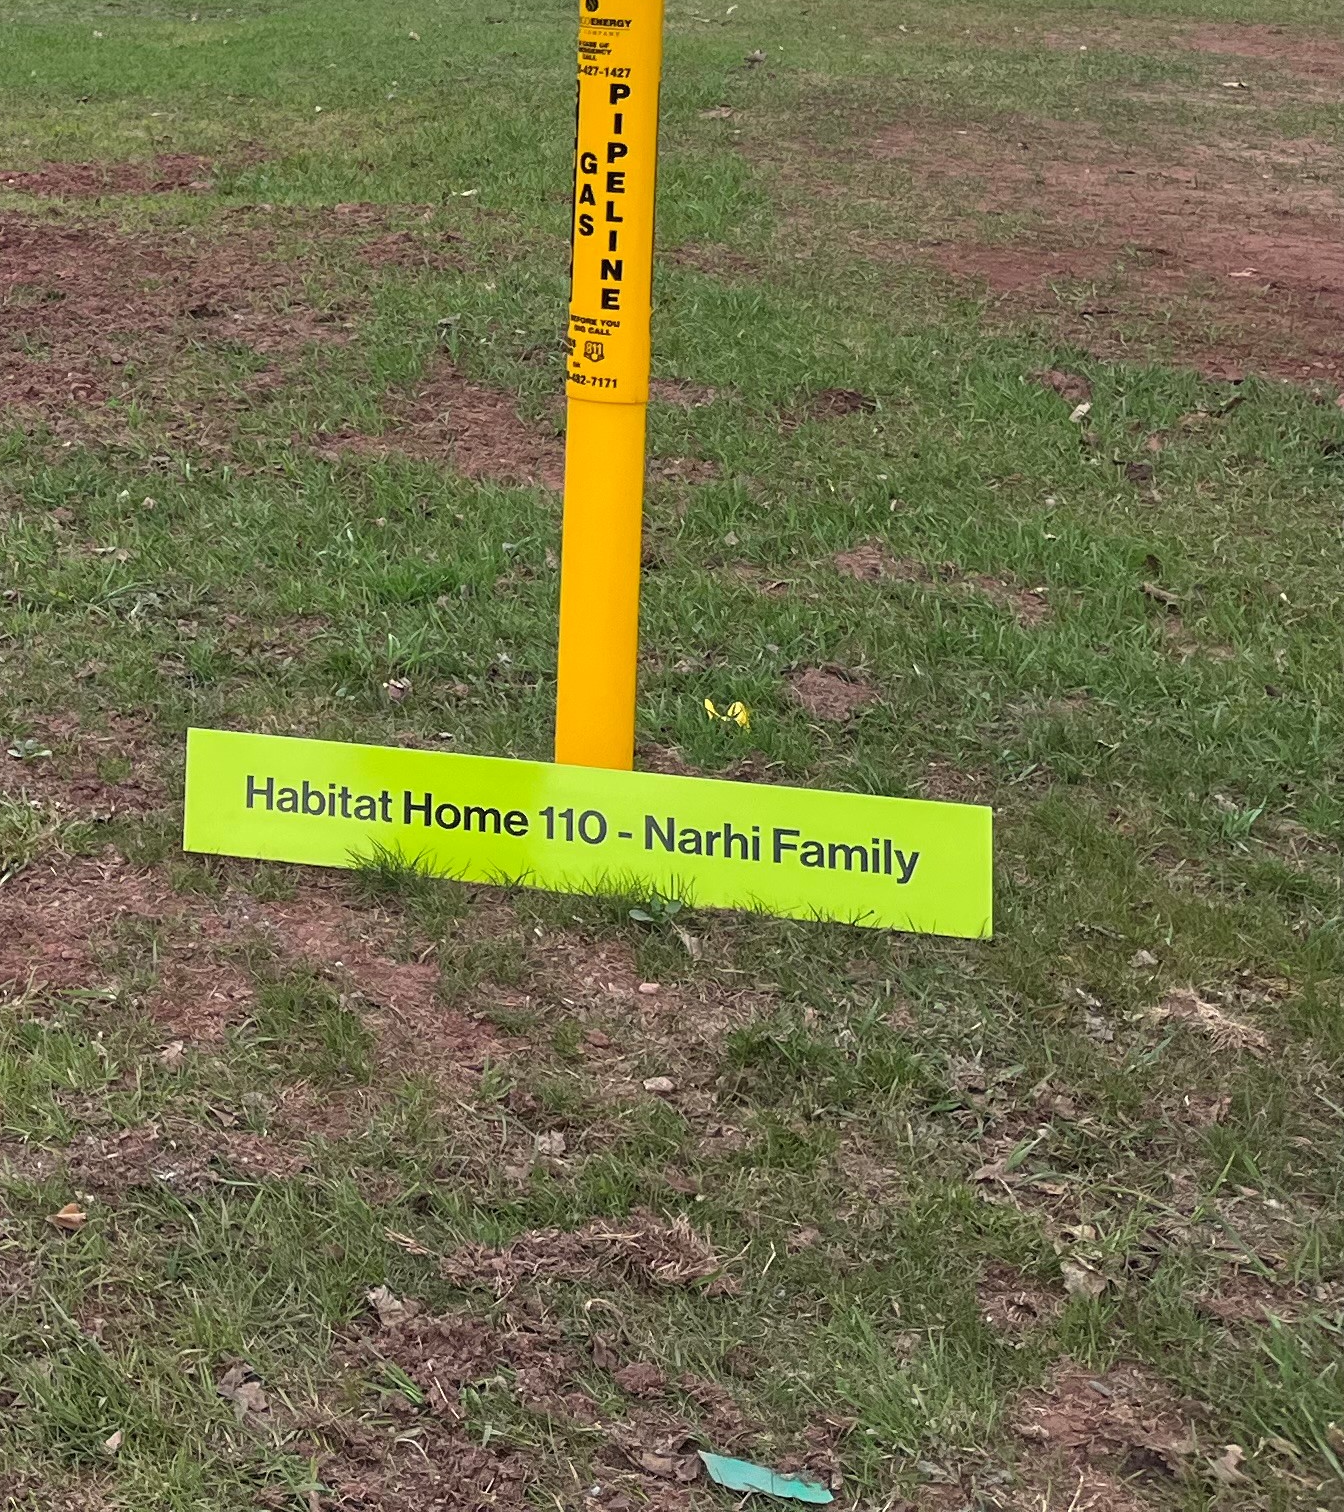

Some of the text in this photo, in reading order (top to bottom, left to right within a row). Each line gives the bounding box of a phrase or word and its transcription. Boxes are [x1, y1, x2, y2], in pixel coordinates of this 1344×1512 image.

[578, 151, 598, 236] GAS
[600, 83, 631, 311] PIPELINE
[585, 342, 603, 356] 811
[600, 319, 621, 328] YOU
[245, 774, 393, 823] Habitat
[403, 790, 529, 837] Home
[538, 805, 608, 845] 110
[644, 814, 760, 862] Narhi
[772, 827, 920, 885] Family
